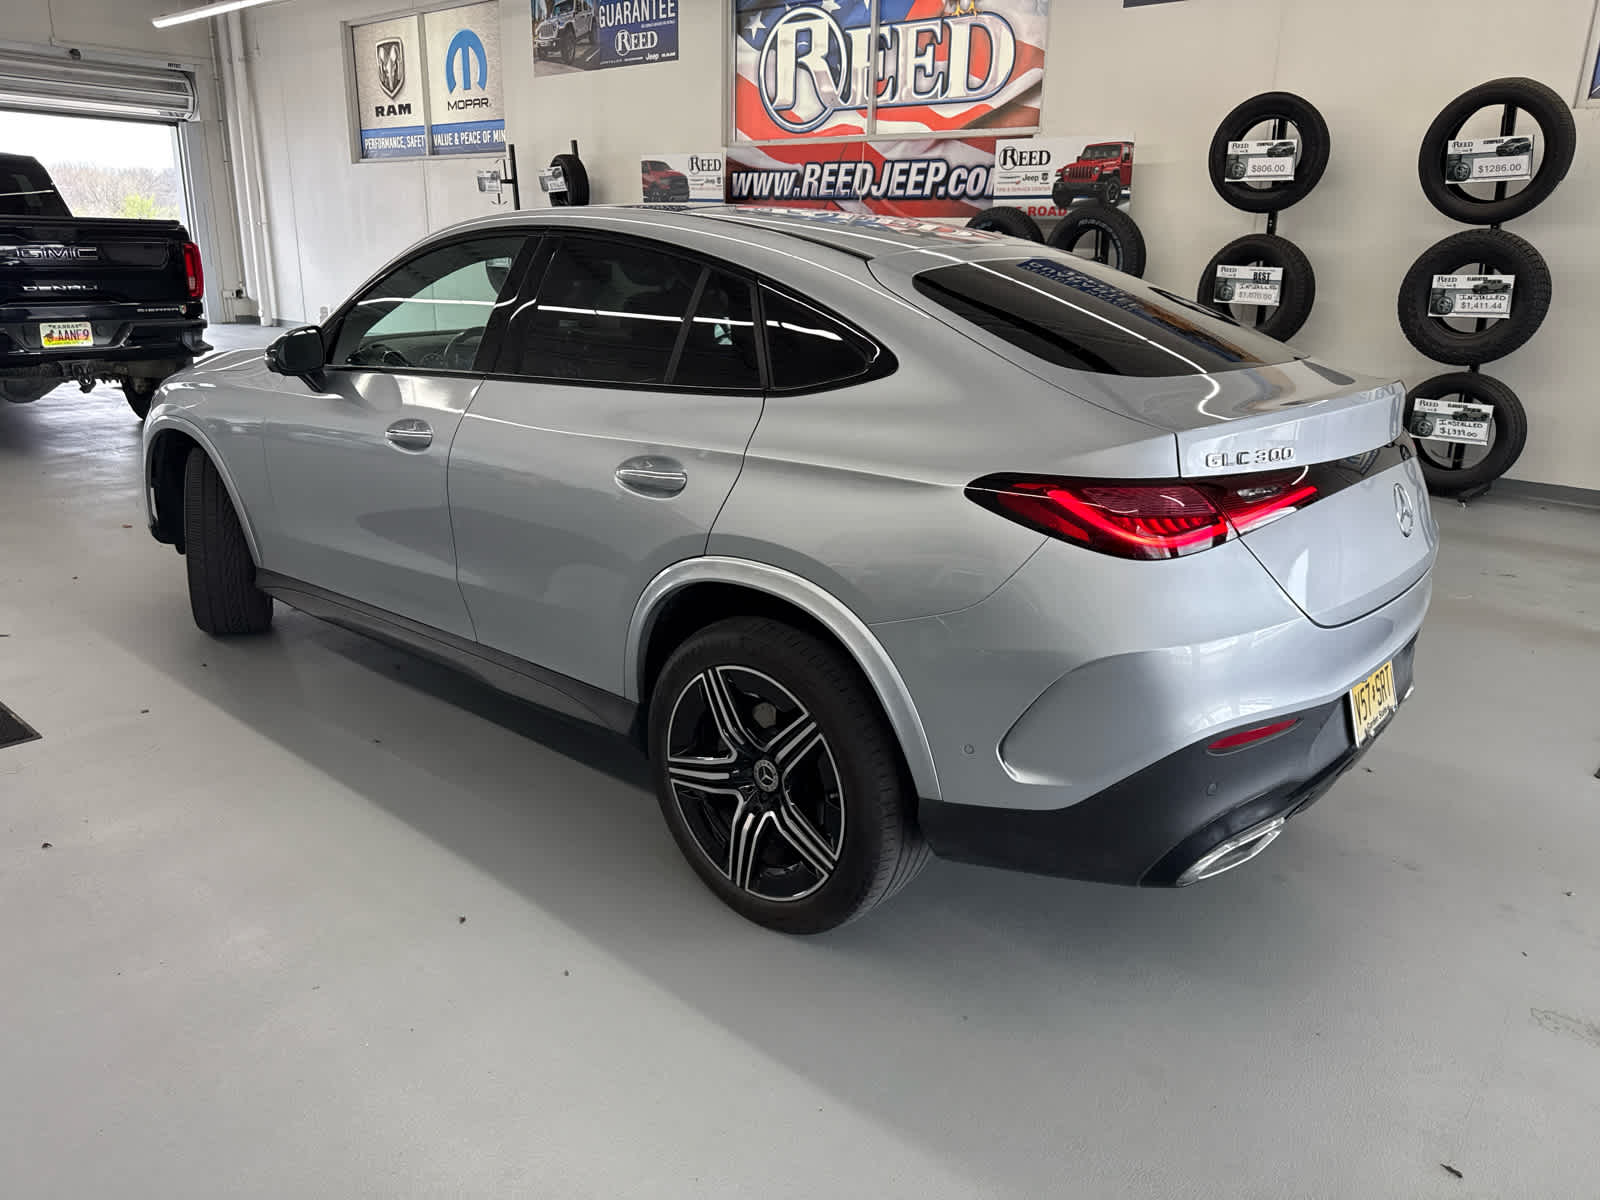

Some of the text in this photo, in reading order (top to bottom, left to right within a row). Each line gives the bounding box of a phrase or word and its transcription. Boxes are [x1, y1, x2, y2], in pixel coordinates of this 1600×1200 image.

[599, 0, 676, 28] GUARANTEE
[615, 30, 658, 54] REED
[765, 10, 1015, 122] REED
[375, 103, 412, 117] RAM
[447, 98, 489, 111] MOPAR
[364, 135, 407, 150] PERFORMANCE,
[406, 134, 425, 147] SAFET
[433, 132, 453, 146] VALUE
[460, 130, 480, 144] PEACE
[482, 130, 491, 143] OF
[493, 129, 506, 142] MIN
[689, 156, 721, 173] REED
[999, 148, 1051, 168] REED
[1251, 164, 1286, 173] $806.00
[17, 247, 98, 260] GMC
[1253, 271, 1271, 281] BEST
[1206, 447, 1295, 467] GLC 300
